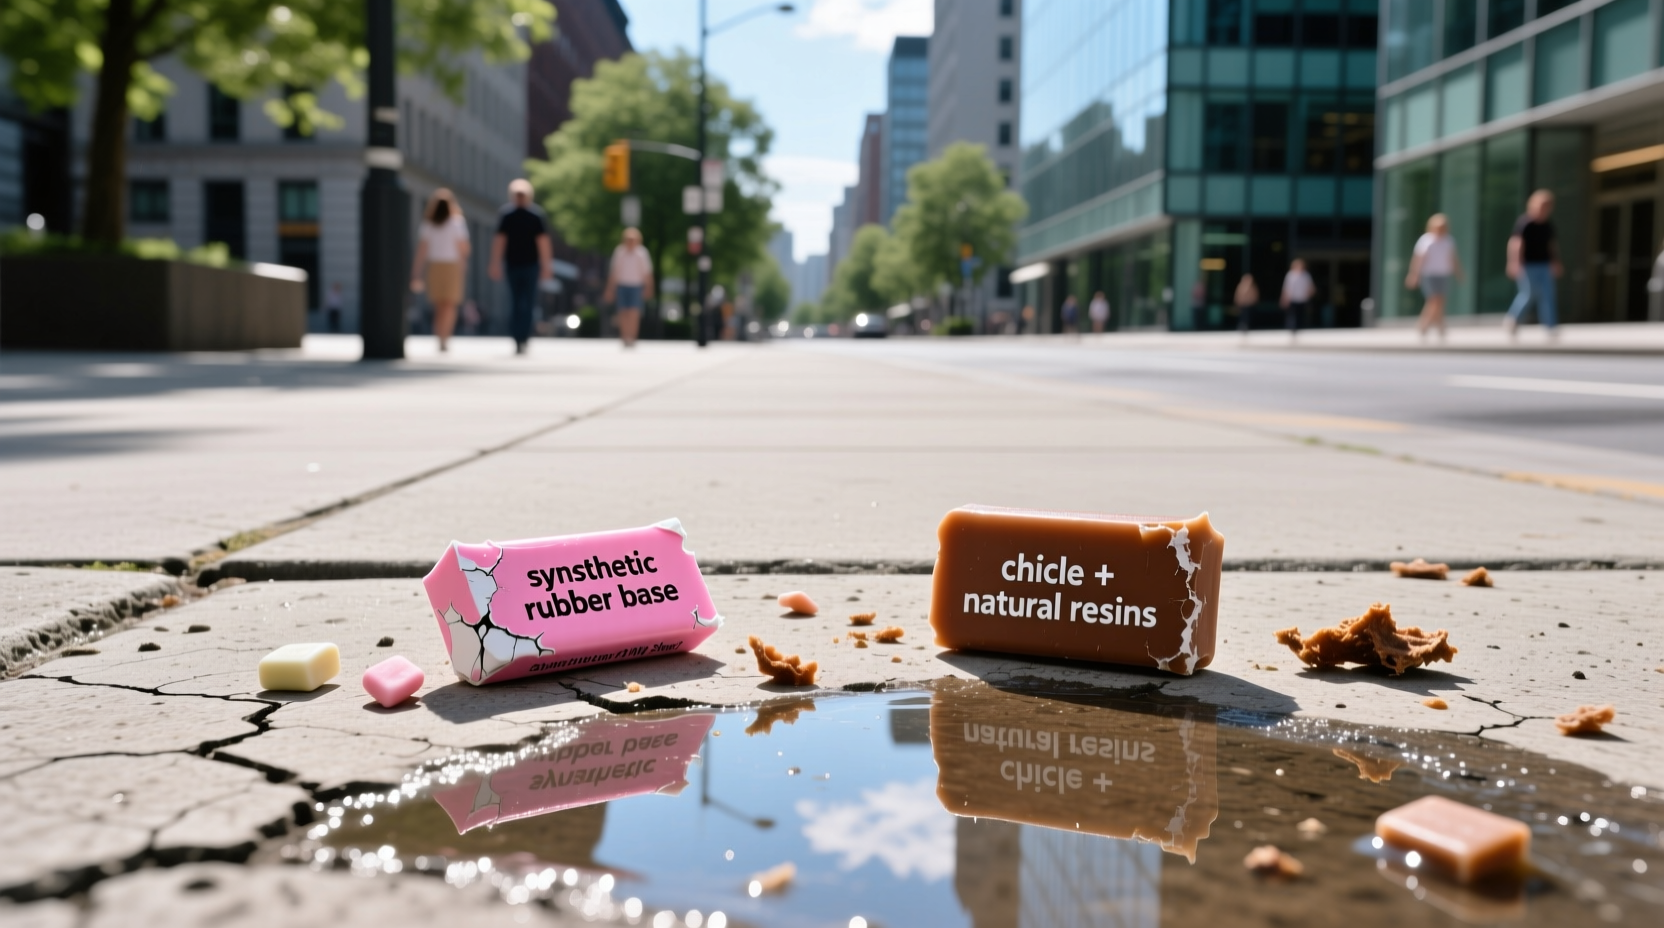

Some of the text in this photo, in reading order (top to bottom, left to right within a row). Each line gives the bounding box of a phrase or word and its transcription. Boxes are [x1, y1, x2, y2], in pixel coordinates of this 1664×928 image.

[526, 550, 658, 592] synsthetic
[1001, 552, 1115, 586] chicle +
[524, 583, 679, 621] rubber base
[963, 590, 1157, 628] natural resins
